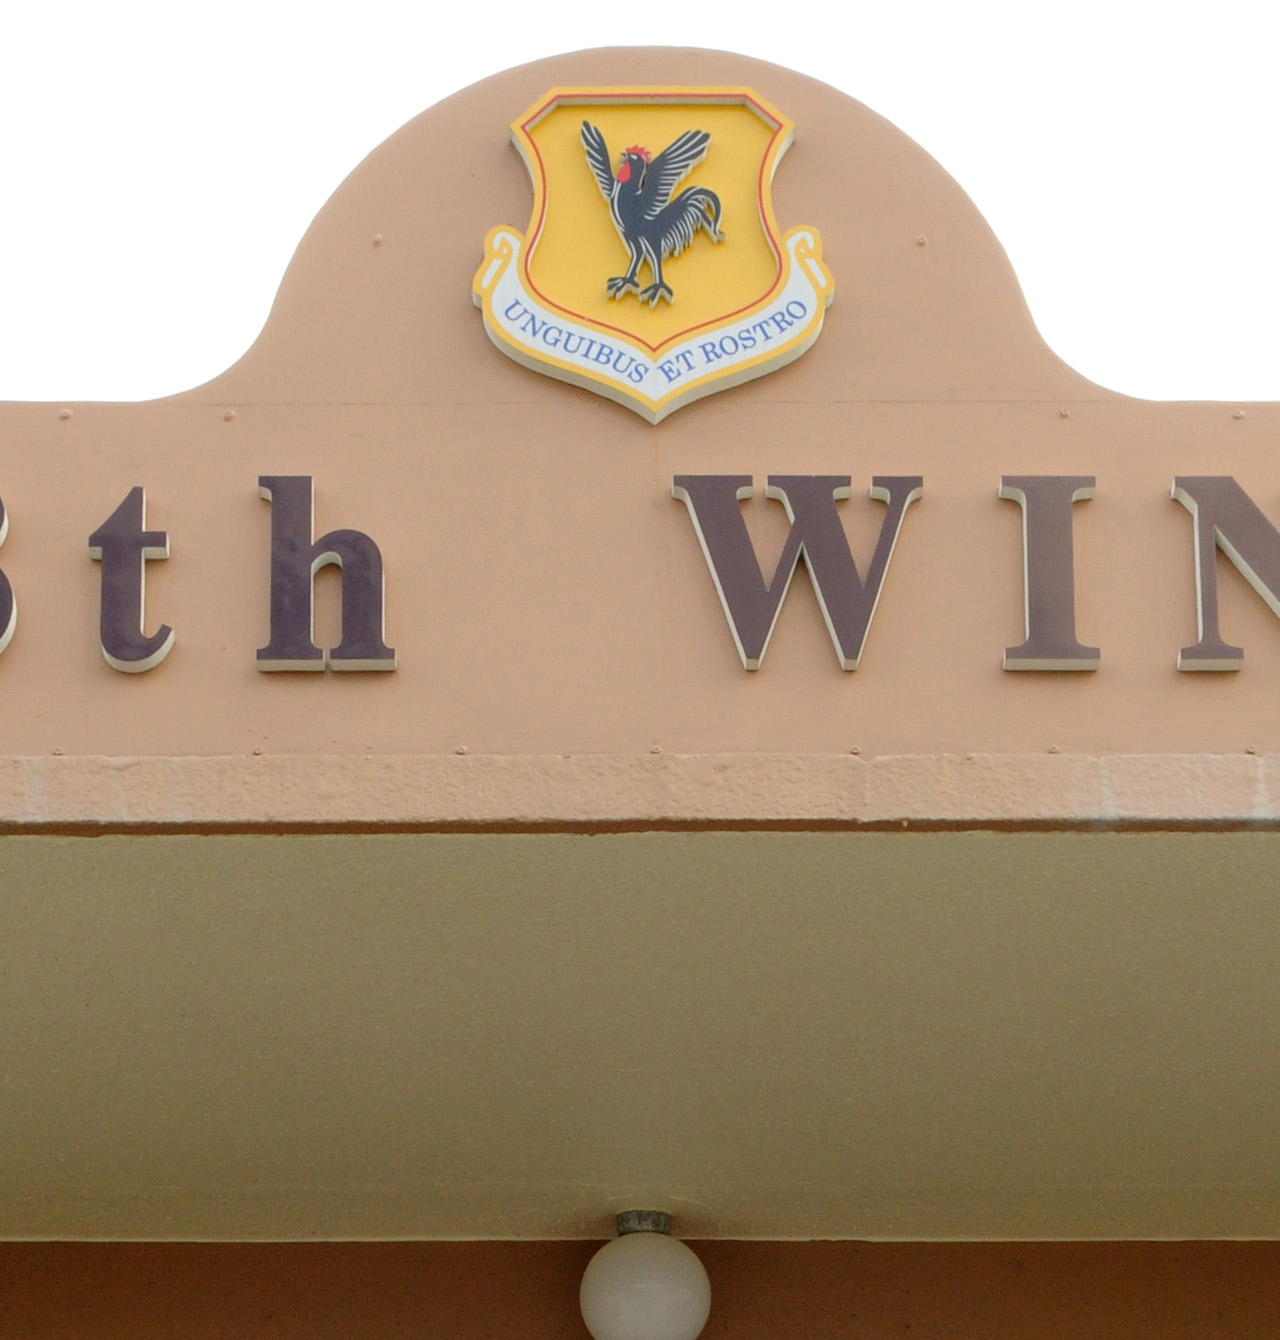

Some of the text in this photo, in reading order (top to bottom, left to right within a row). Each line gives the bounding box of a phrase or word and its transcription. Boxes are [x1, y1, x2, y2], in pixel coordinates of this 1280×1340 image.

[504, 298, 808, 384] UNGUIBUS ET ROSTRO
